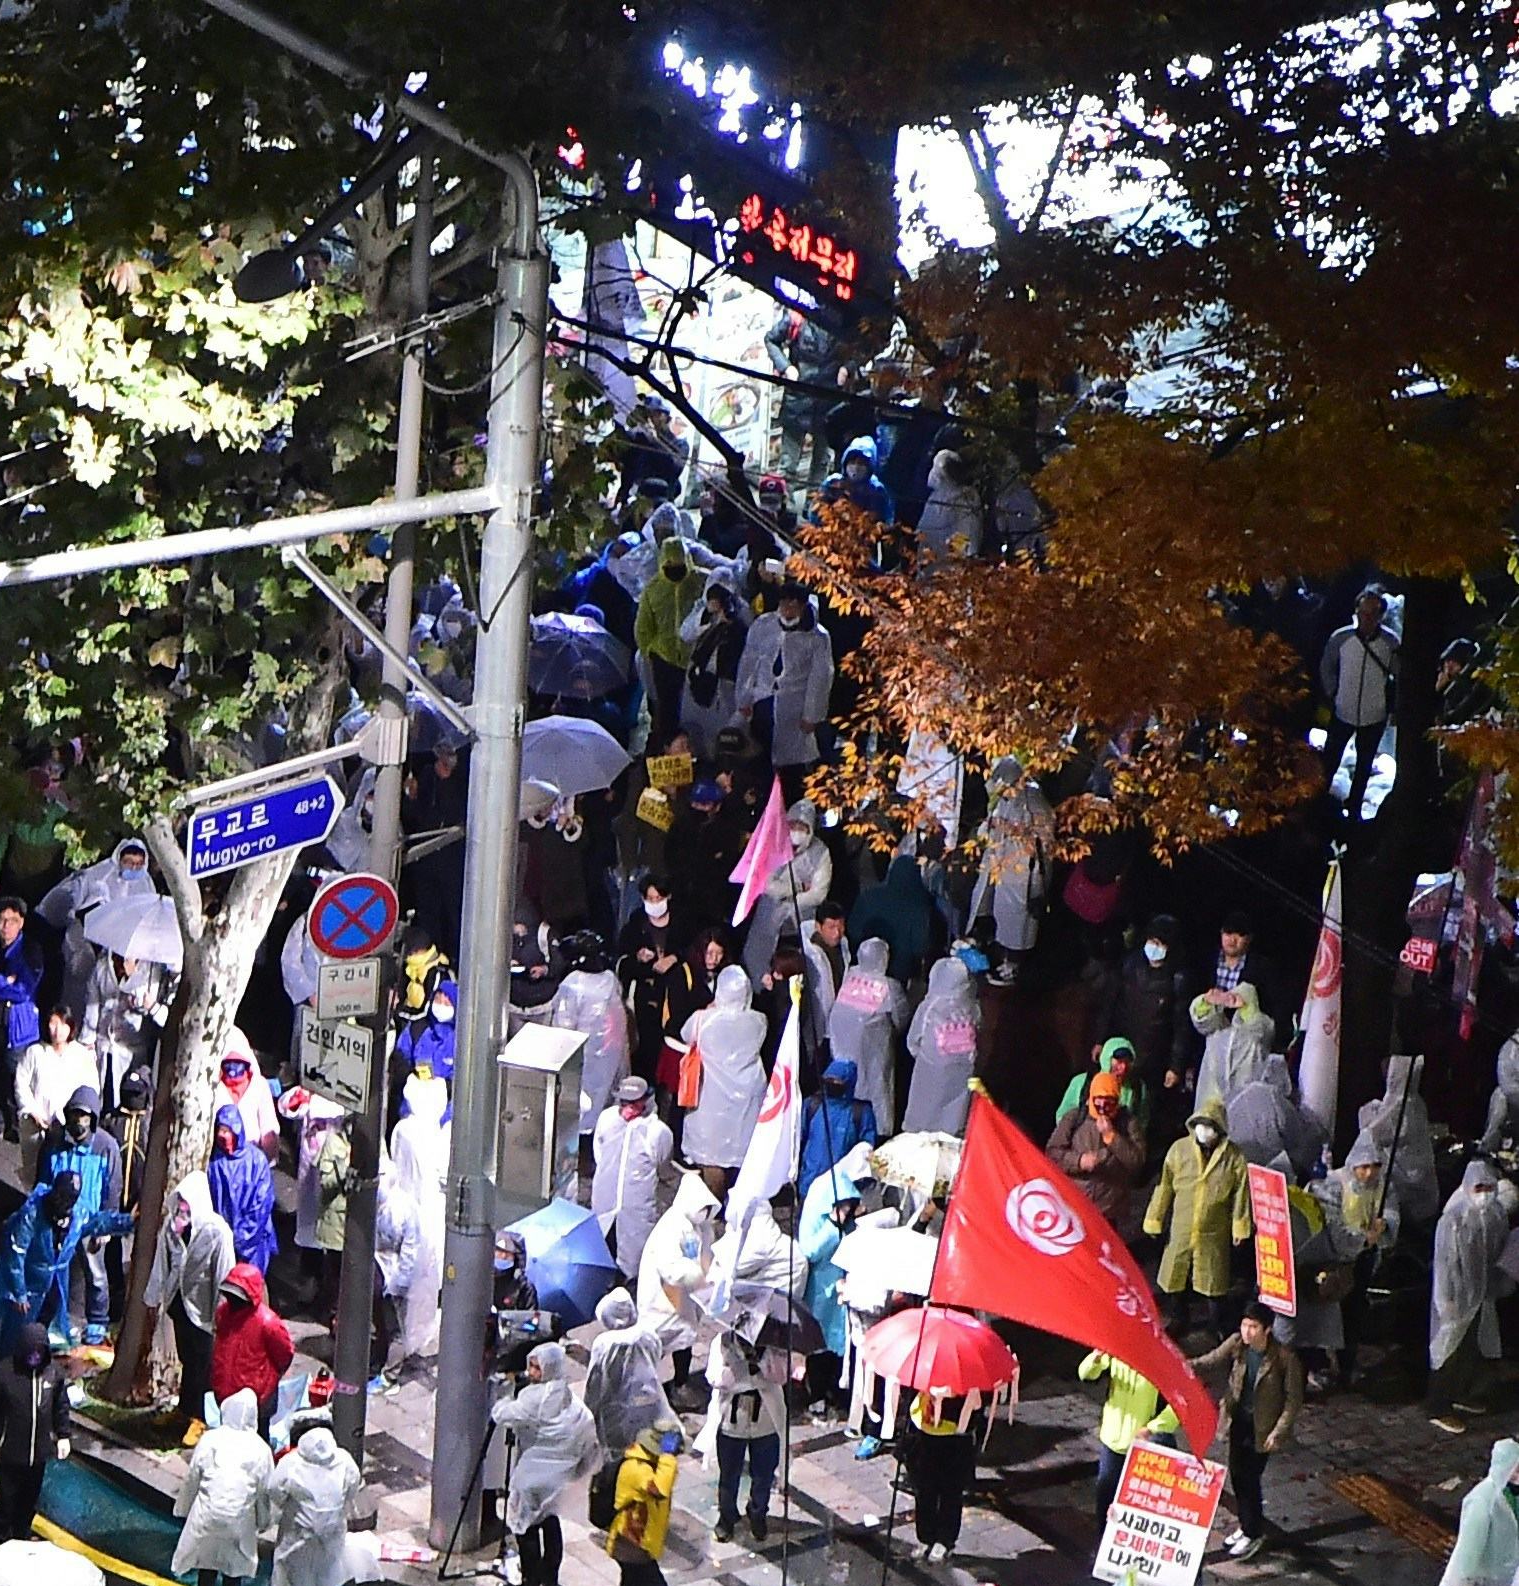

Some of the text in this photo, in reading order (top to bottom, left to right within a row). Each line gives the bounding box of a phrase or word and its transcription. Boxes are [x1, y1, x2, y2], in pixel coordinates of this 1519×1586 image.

[196, 803, 270, 847] 무교로
[195, 834, 277, 871] Mugyo-ro
[1400, 949, 1430, 967] OUT
